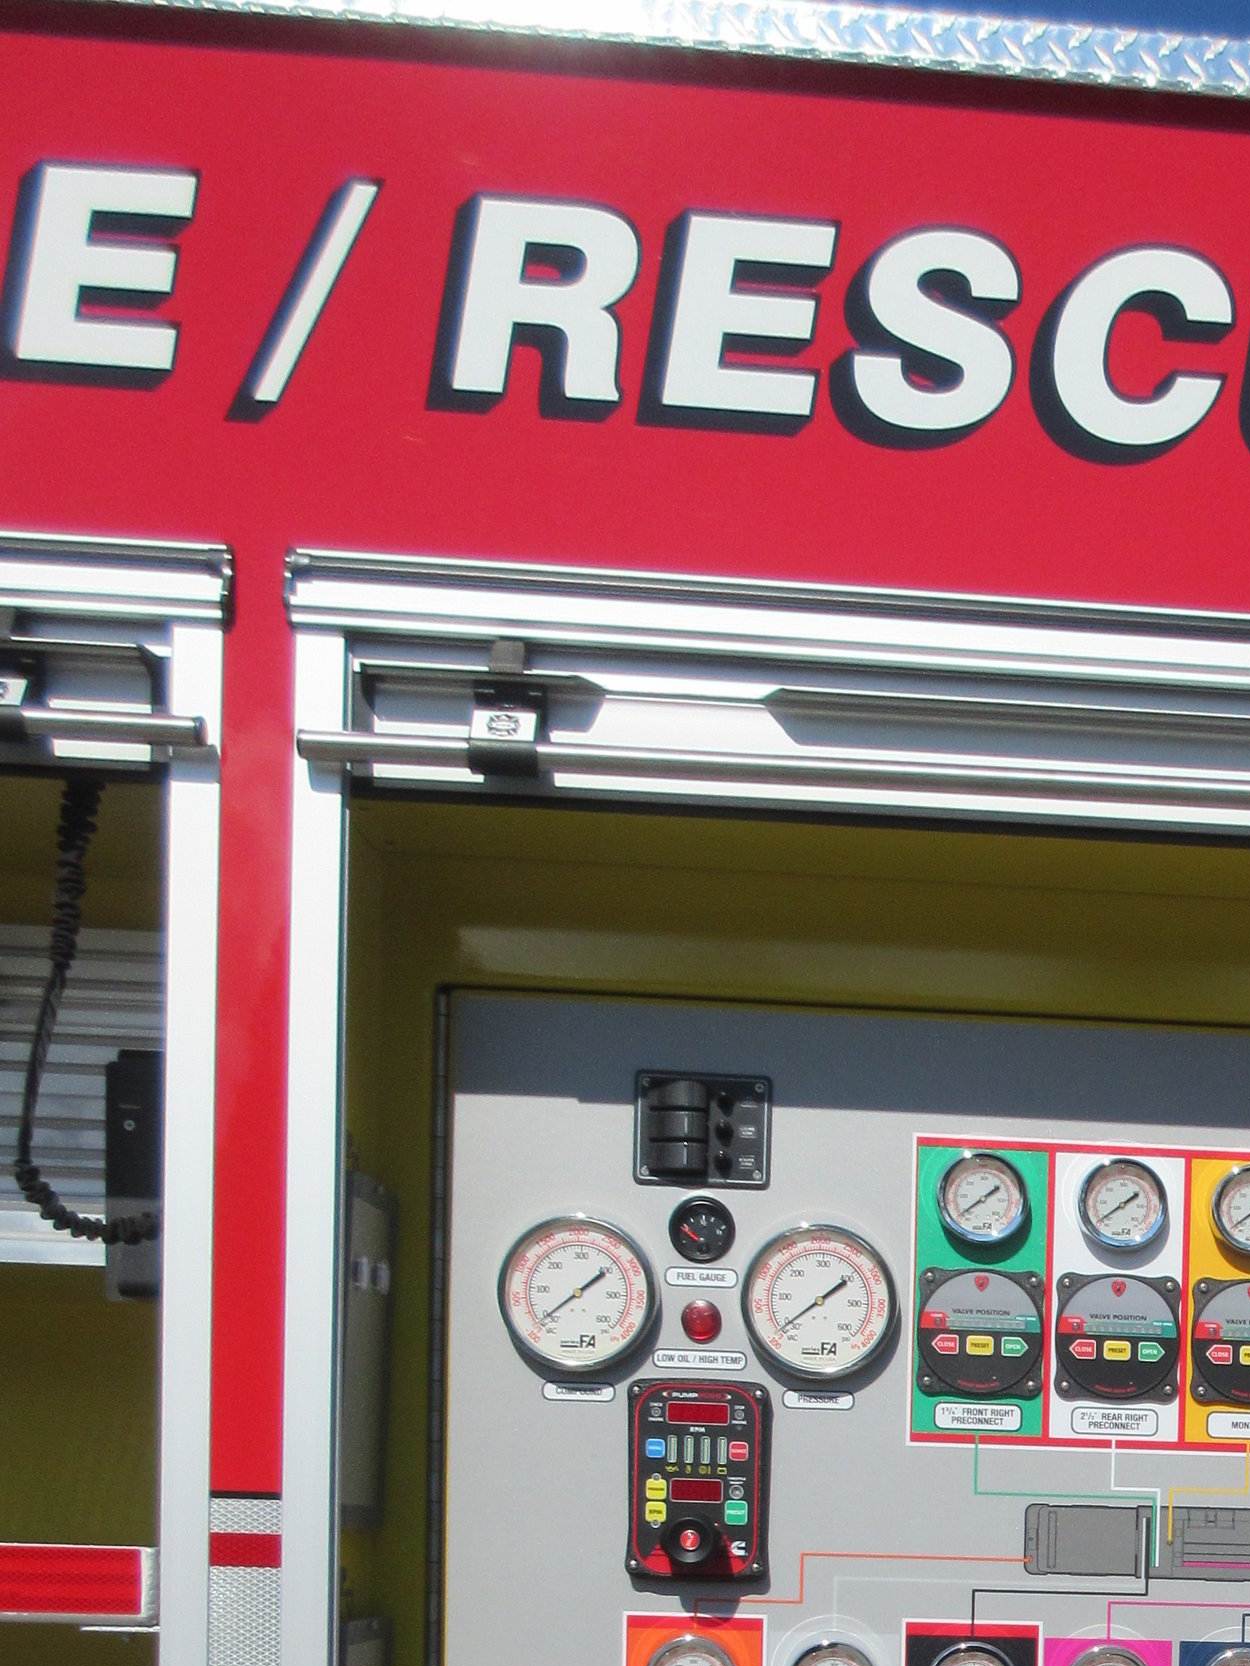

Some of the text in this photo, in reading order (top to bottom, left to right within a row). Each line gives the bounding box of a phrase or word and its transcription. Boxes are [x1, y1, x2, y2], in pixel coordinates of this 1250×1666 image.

[574, 1252, 589, 1260] 300
[677, 1272, 726, 1281] FUEL GAUGE
[596, 1315, 611, 1323] 600
[580, 1334, 596, 1348] FA
[821, 1342, 837, 1356] FA
[657, 1354, 674, 1362] LOW
[677, 1354, 689, 1363] OIL
[699, 1355, 718, 1364] HIGH
[721, 1356, 743, 1365] TEMP
[797, 1395, 840, 1404] PRESSURE
[962, 1408, 989, 1416] FRONT
[991, 1408, 1015, 1417] RIGHT
[1101, 1412, 1123, 1421] REAR
[1125, 1413, 1149, 1422] RIGHT
[951, 1416, 1004, 1426] PRECONNECT
[1088, 1421, 1140, 1430] PRECONNECT
